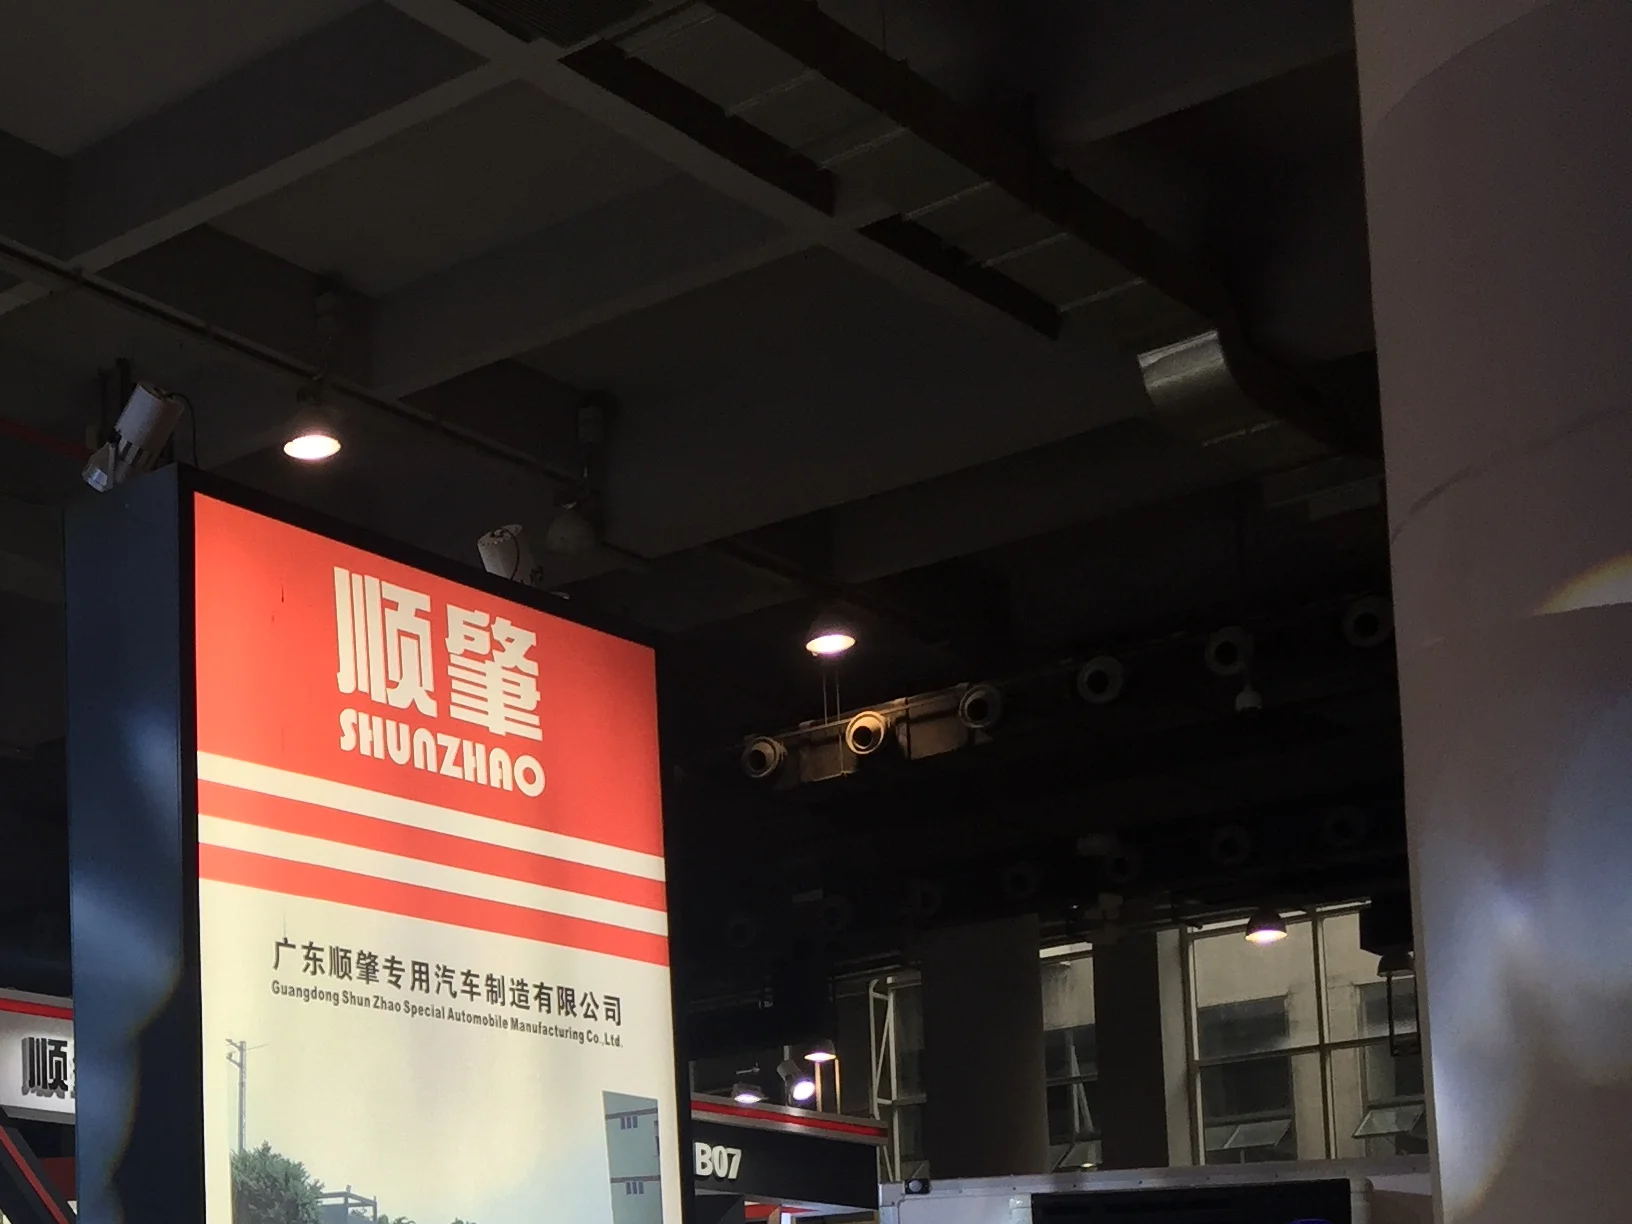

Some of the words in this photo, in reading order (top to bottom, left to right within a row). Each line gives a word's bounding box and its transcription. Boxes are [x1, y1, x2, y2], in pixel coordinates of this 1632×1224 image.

[334, 567, 543, 742] 顺肇
[339, 707, 546, 798] SHUNZHAO
[271, 980, 340, 1006] Guangdong
[342, 989, 371, 1009] Shun
[373, 996, 401, 1013] Zhao
[403, 1000, 445, 1021] Special
[448, 1008, 508, 1030] Automobile
[510, 1017, 585, 1044] Manufacturing
[273, 938, 622, 1027] 广东顺肇专用汽车制造有限公司
